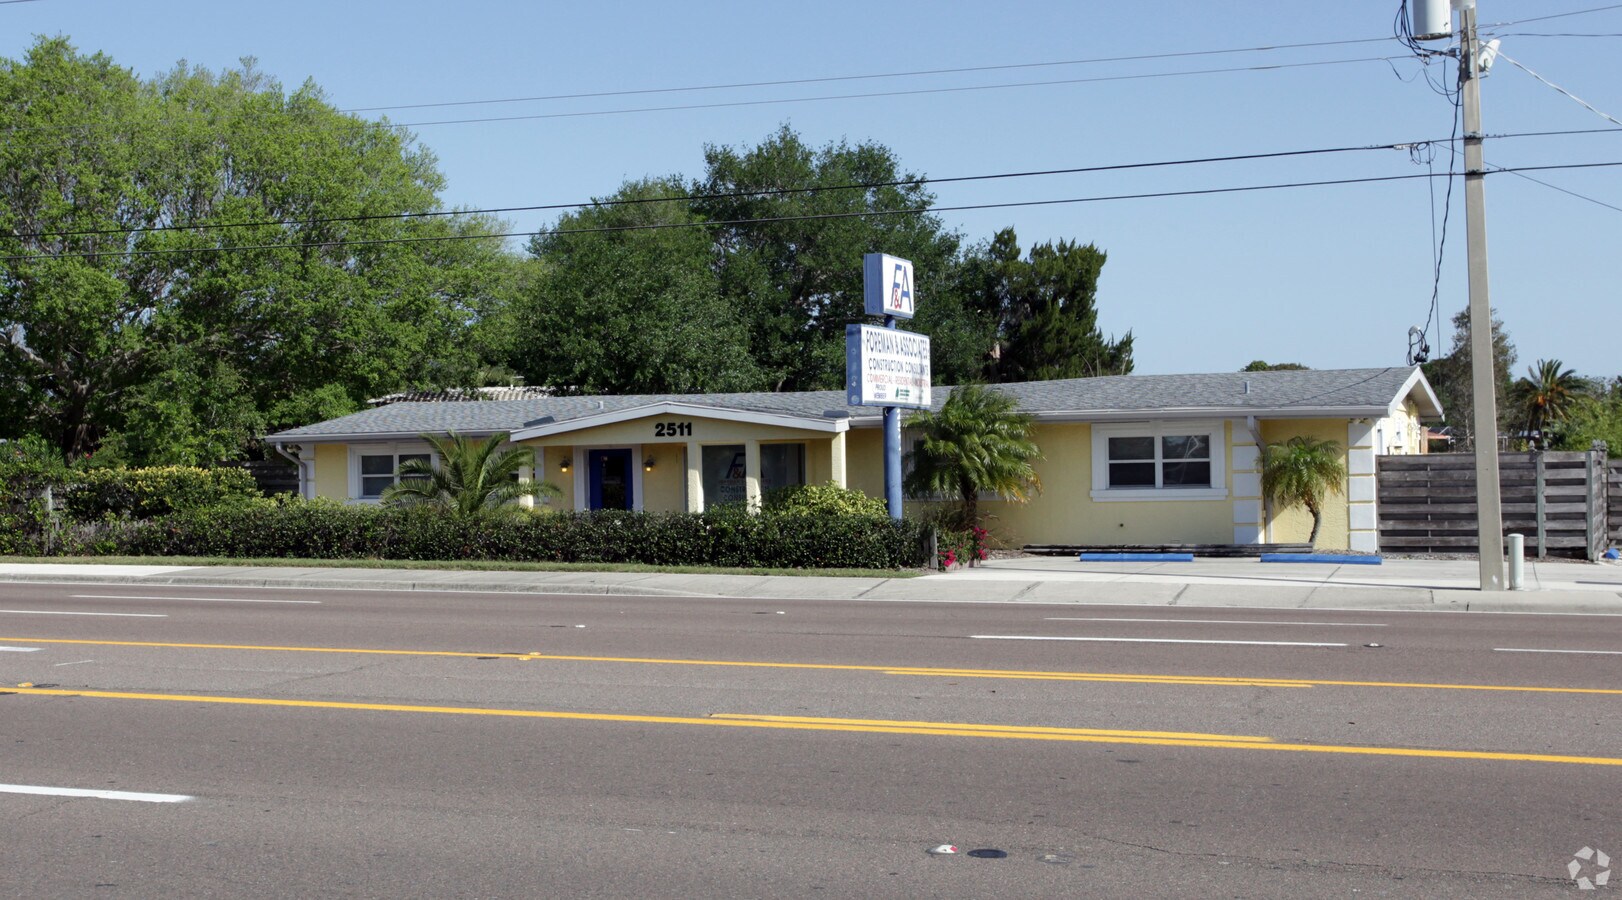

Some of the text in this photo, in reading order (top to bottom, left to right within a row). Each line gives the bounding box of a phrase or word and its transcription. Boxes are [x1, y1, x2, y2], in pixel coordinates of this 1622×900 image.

[866, 330, 894, 355] FOREMAN
[868, 357, 903, 373] CONSTRUCTION
[655, 422, 692, 437] 2511
